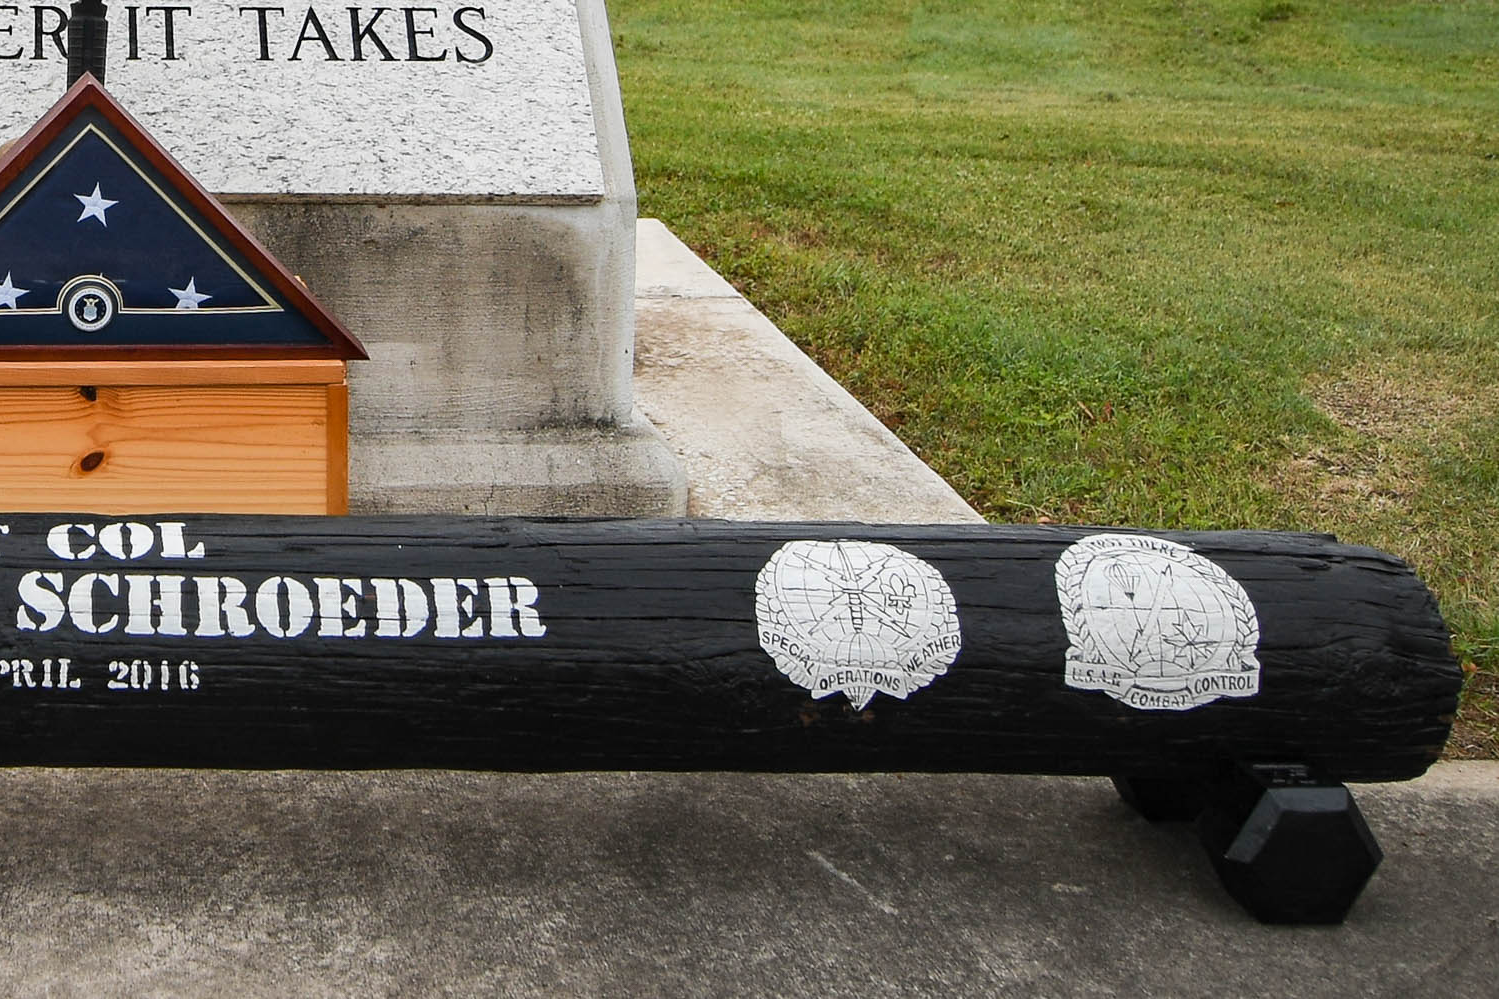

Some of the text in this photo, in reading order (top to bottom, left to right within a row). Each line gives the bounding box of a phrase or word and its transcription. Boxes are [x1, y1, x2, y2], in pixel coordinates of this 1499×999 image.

[125, 6, 191, 61] IT
[239, 6, 494, 64] TAKES
[47, 522, 205, 559] COL
[16, 570, 547, 639] SCHROEDER
[107, 659, 200, 691] 2016
[761, 631, 961, 691] SPECIAL OPERATIONS WEATHER
[1130, 692, 1189, 708] COMBAT
[1194, 675, 1254, 694] CONTROL
